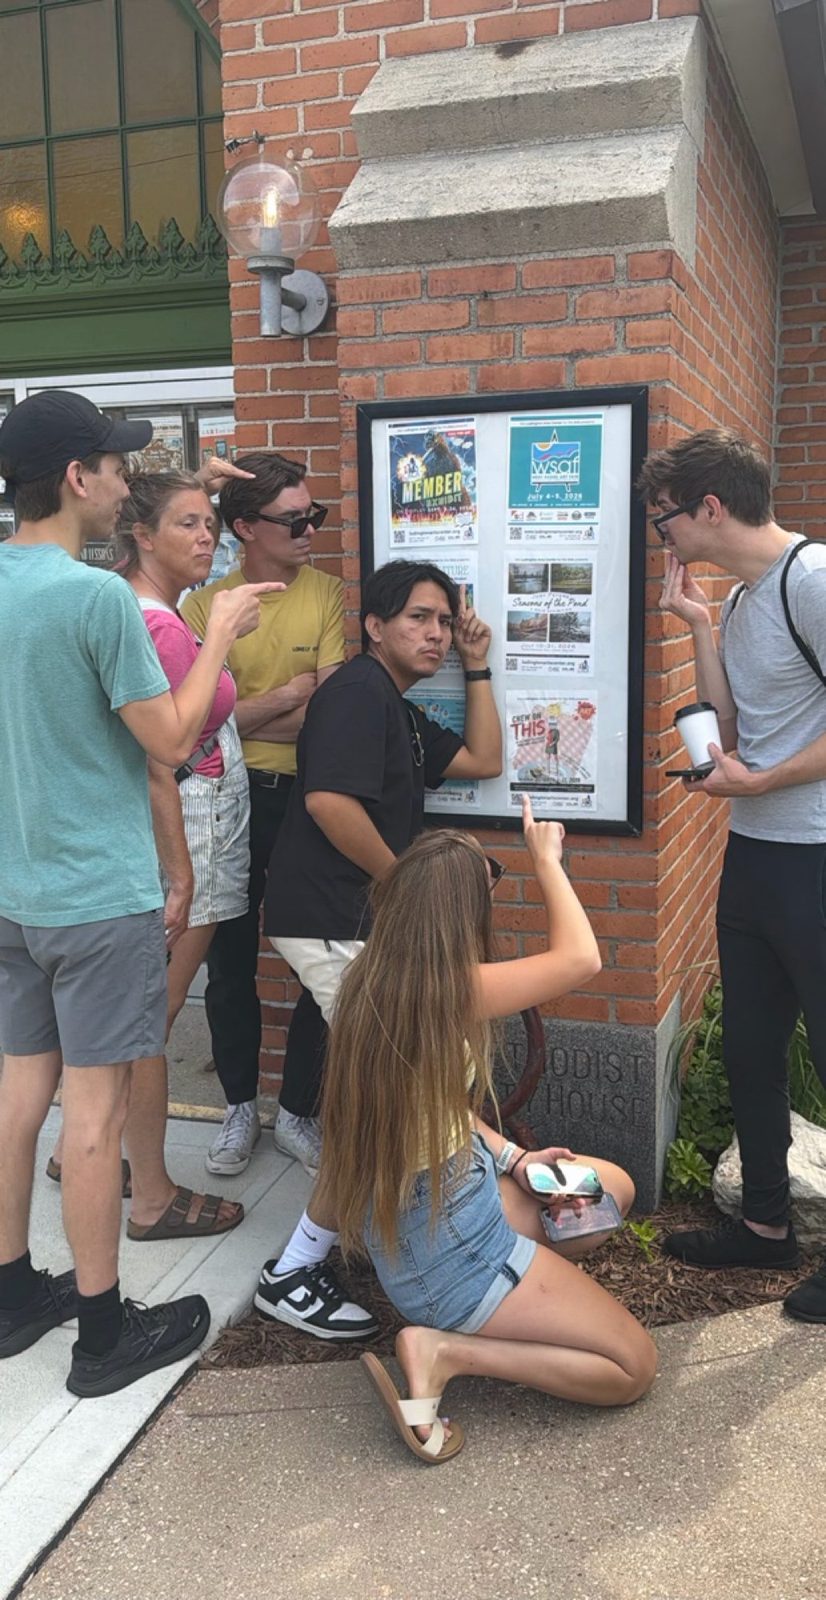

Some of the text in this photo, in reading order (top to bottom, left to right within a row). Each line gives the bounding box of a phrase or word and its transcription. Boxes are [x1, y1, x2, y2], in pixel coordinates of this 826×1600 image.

[531, 456, 580, 475] wsaf
[402, 471, 462, 504] MEMBER
[527, 493, 543, 501] July
[512, 597, 589, 609] Seasons of the Pond
[512, 712, 542, 722] CHEW ON
[510, 719, 546, 740] THIS
[508, 1041, 650, 1085] TODIST
[546, 1082, 649, 1128] HOUSE
